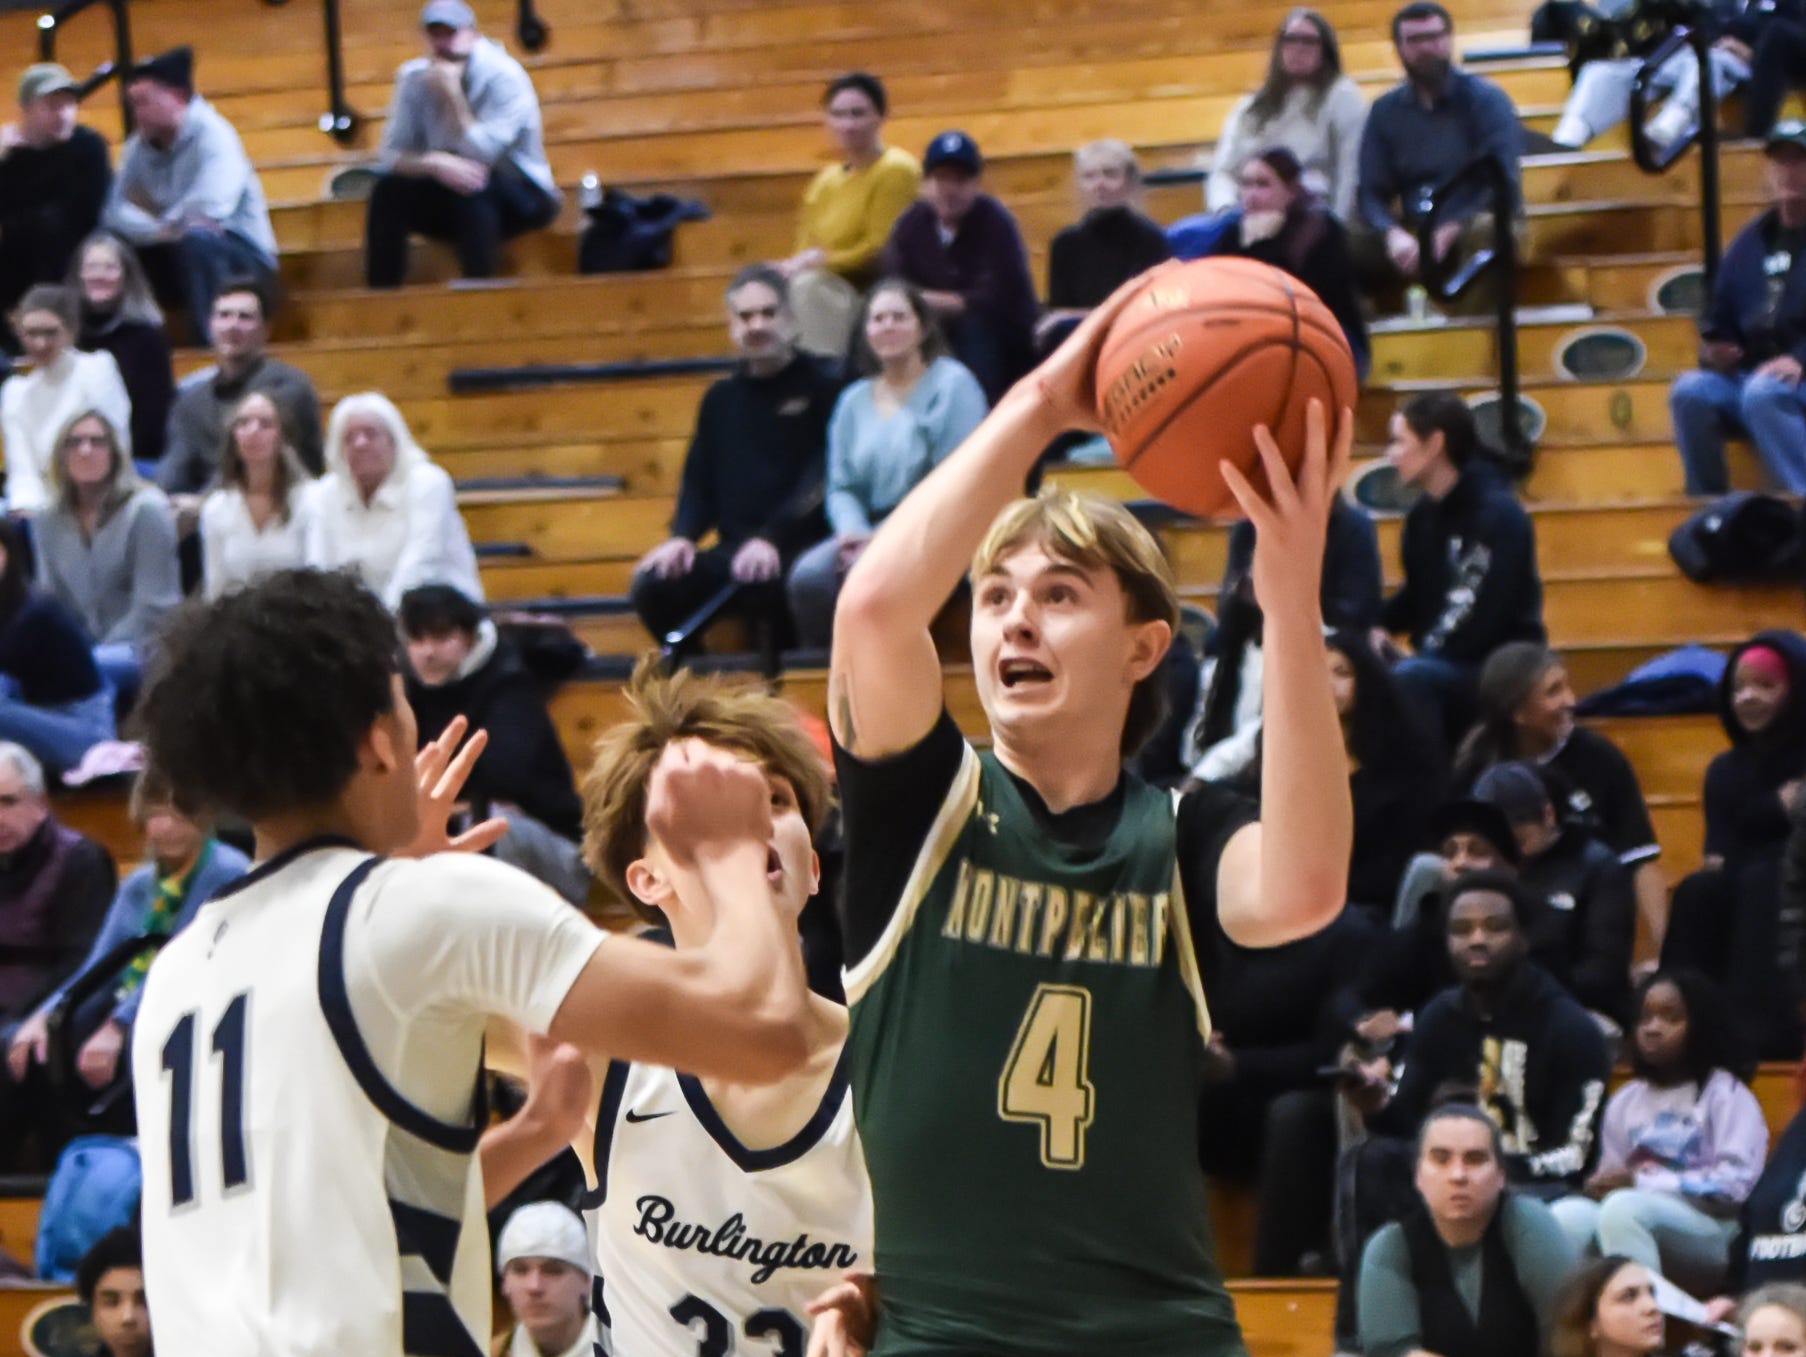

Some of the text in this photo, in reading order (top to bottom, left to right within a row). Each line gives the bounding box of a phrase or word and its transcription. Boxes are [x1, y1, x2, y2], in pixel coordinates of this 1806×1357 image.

[159, 987, 255, 1217] 11
[997, 982, 1095, 1170] 4
[632, 1194, 858, 1284] Burlington
